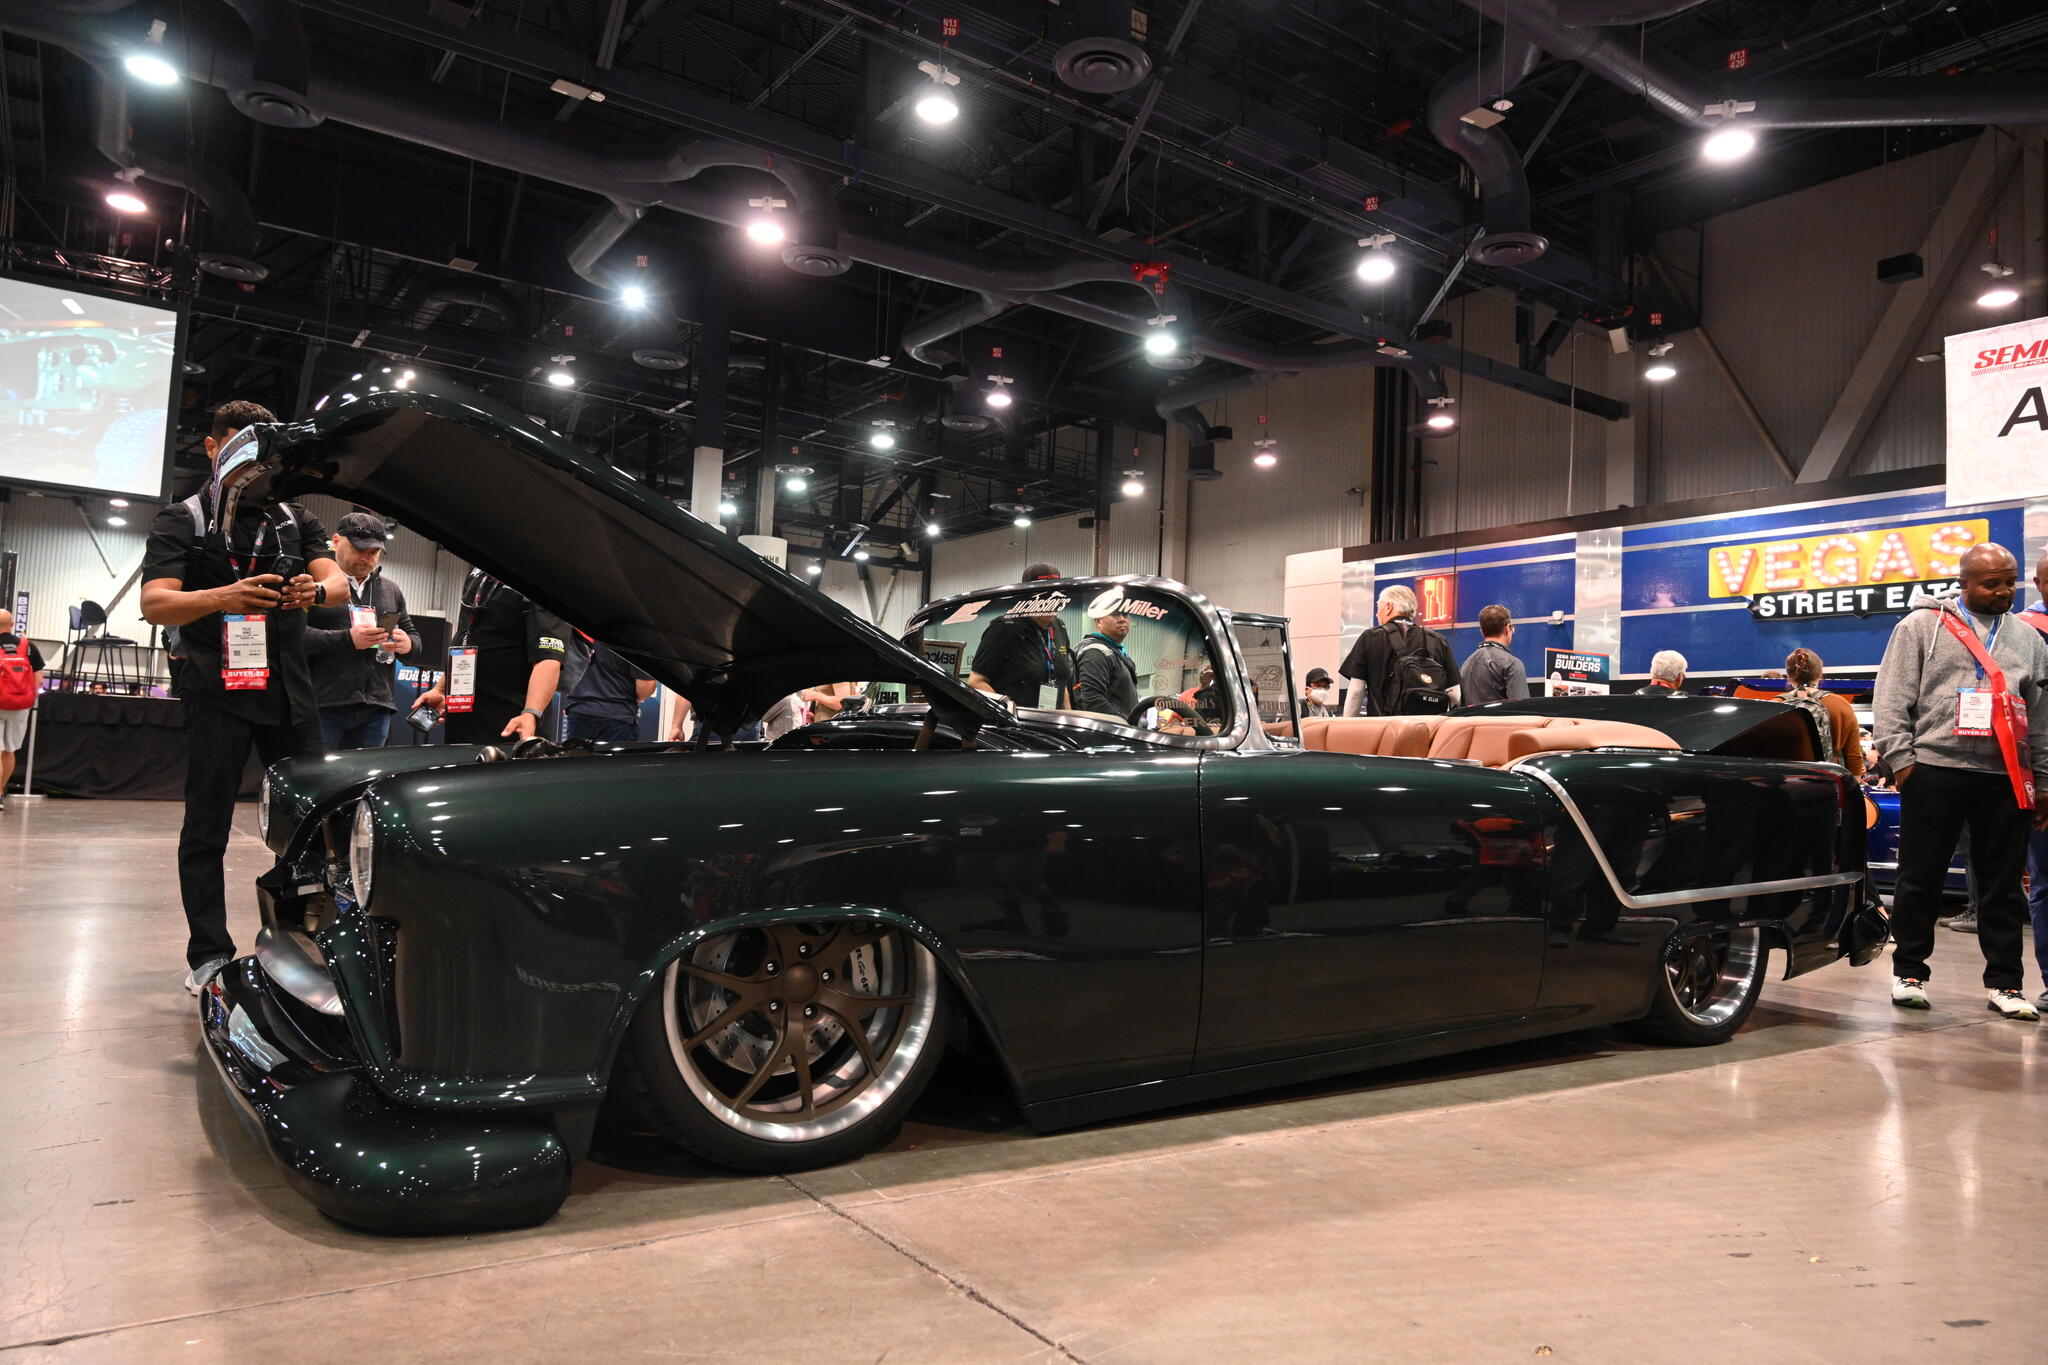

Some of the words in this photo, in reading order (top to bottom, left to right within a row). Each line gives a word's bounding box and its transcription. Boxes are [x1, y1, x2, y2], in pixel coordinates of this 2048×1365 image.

[943, 26, 957, 36] 319
[1729, 59, 1745, 69] 420
[1716, 525, 1974, 594] VEGAS
[1118, 598, 1169, 620] Miller
[1759, 588, 1874, 618] STREET
[1555, 659, 1601, 672] BUILDERS
